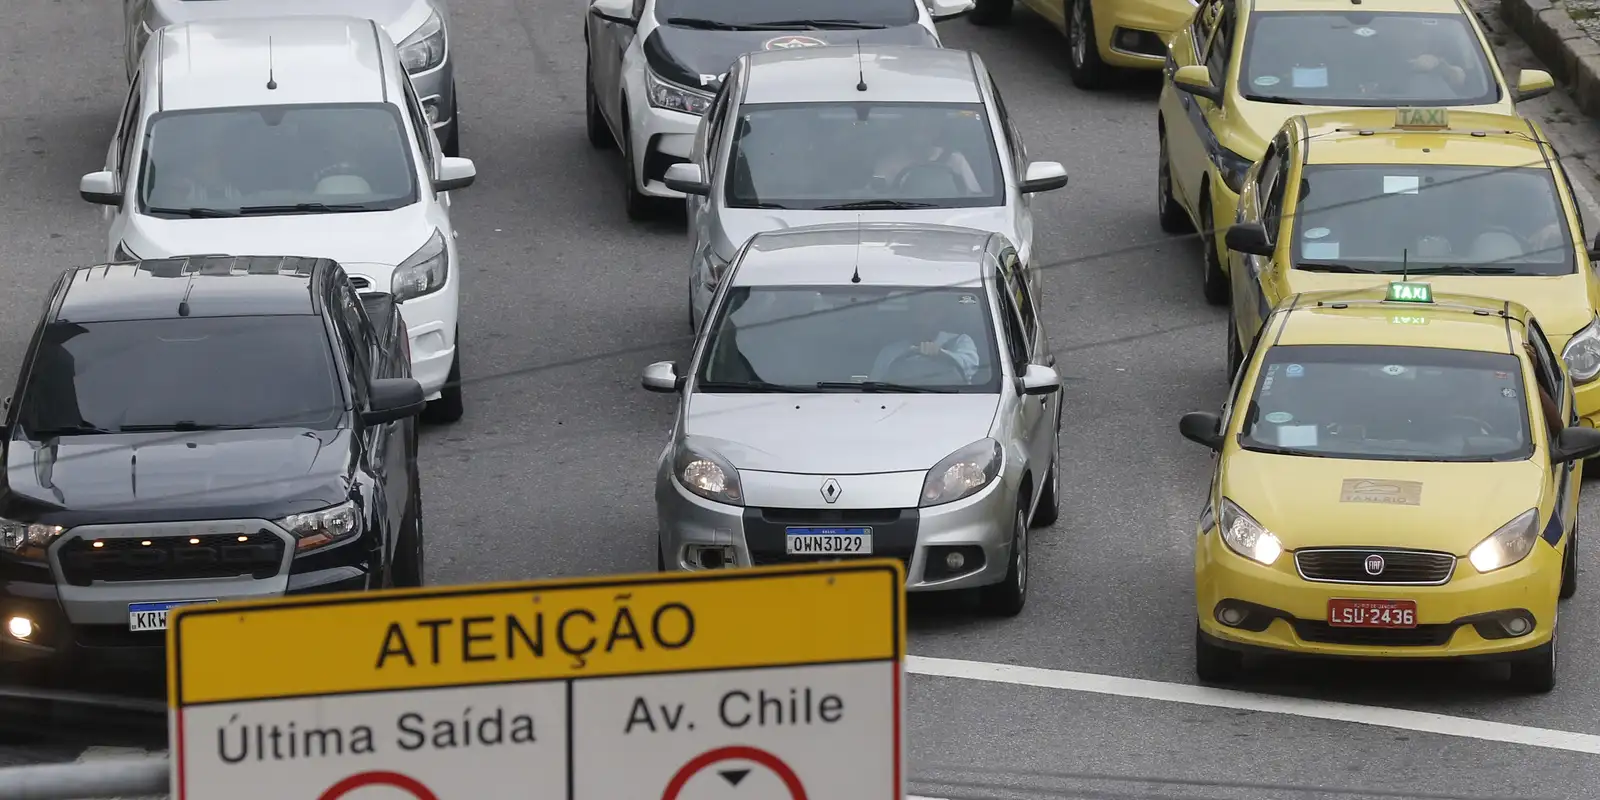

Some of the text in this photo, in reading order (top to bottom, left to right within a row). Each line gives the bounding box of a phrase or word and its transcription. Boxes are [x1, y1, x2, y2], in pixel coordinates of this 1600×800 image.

[1398, 108, 1445, 125] TAXI
[1392, 284, 1428, 300] TAXI
[793, 536, 863, 552] OWN3D29
[1368, 560, 1381, 570] FIAT
[374, 592, 696, 670] ATENÇÃO
[624, 687, 844, 735] Av. Chile
[217, 706, 537, 764] Última Saída
